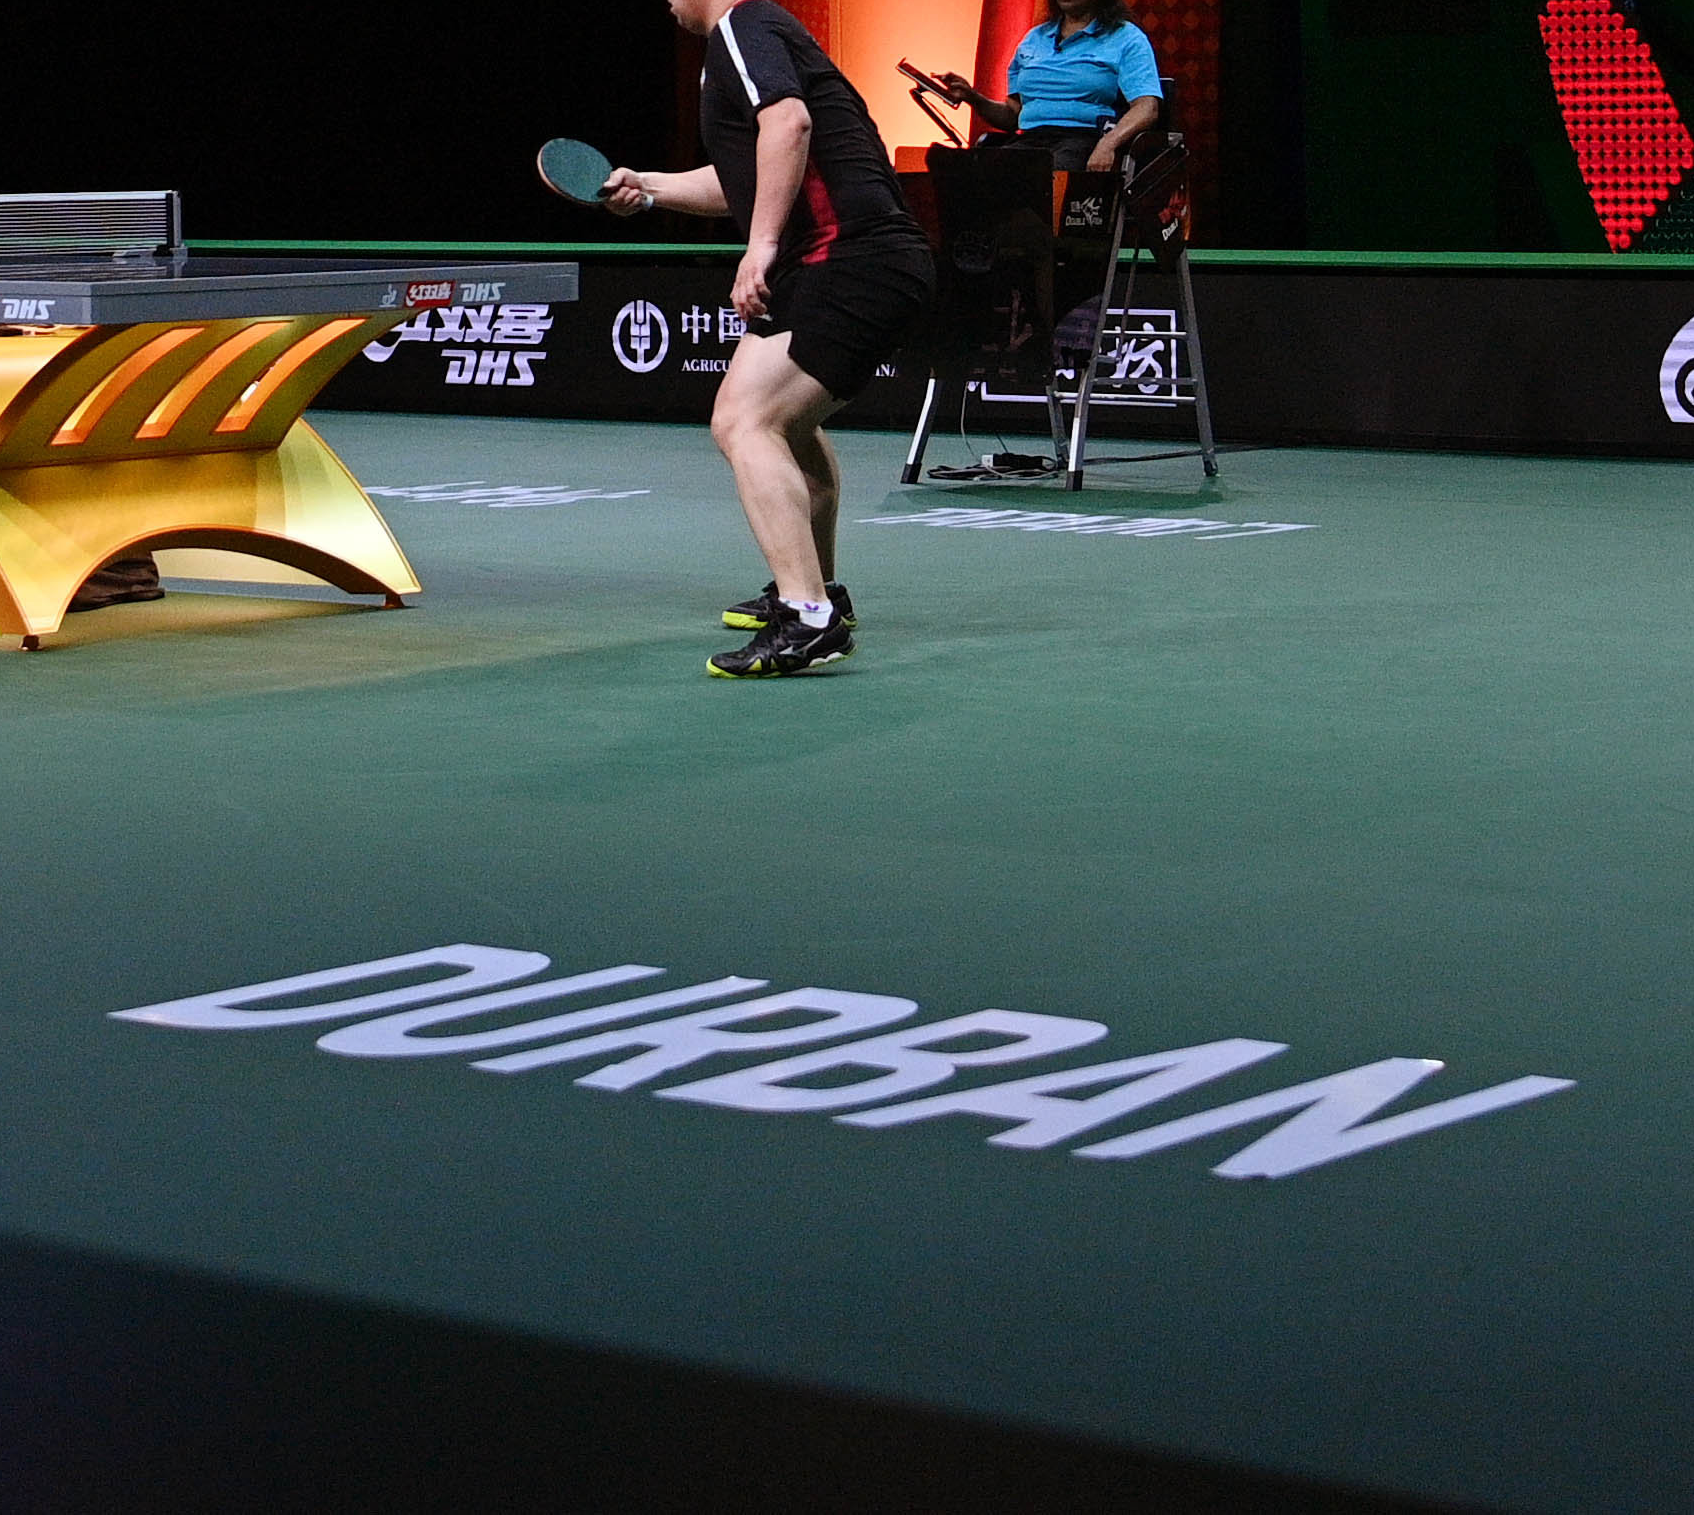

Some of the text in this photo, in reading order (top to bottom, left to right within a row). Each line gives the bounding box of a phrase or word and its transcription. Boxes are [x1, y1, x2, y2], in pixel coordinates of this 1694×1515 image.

[460, 283, 505, 302] DHS
[2, 299, 55, 320] DHS
[441, 349, 547, 386] DHS
[107, 942, 1578, 1180] DURBAN
